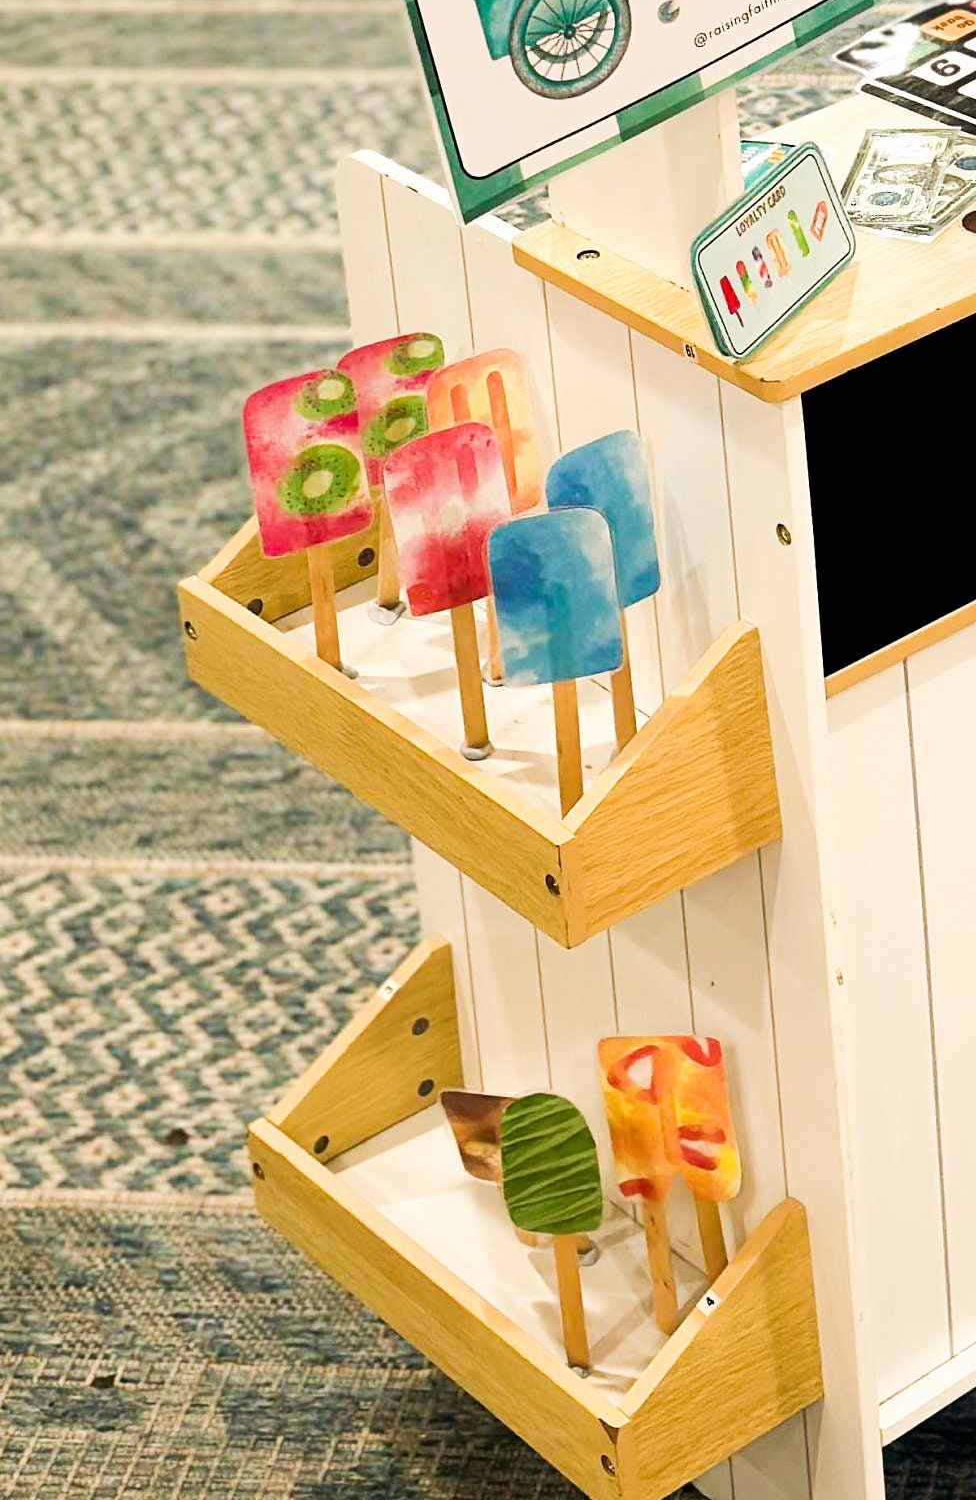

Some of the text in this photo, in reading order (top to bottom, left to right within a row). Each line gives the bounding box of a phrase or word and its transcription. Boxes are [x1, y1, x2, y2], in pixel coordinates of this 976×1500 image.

[930, 58, 961, 77] 9
[735, 185, 786, 237] LOYALTY CARD
